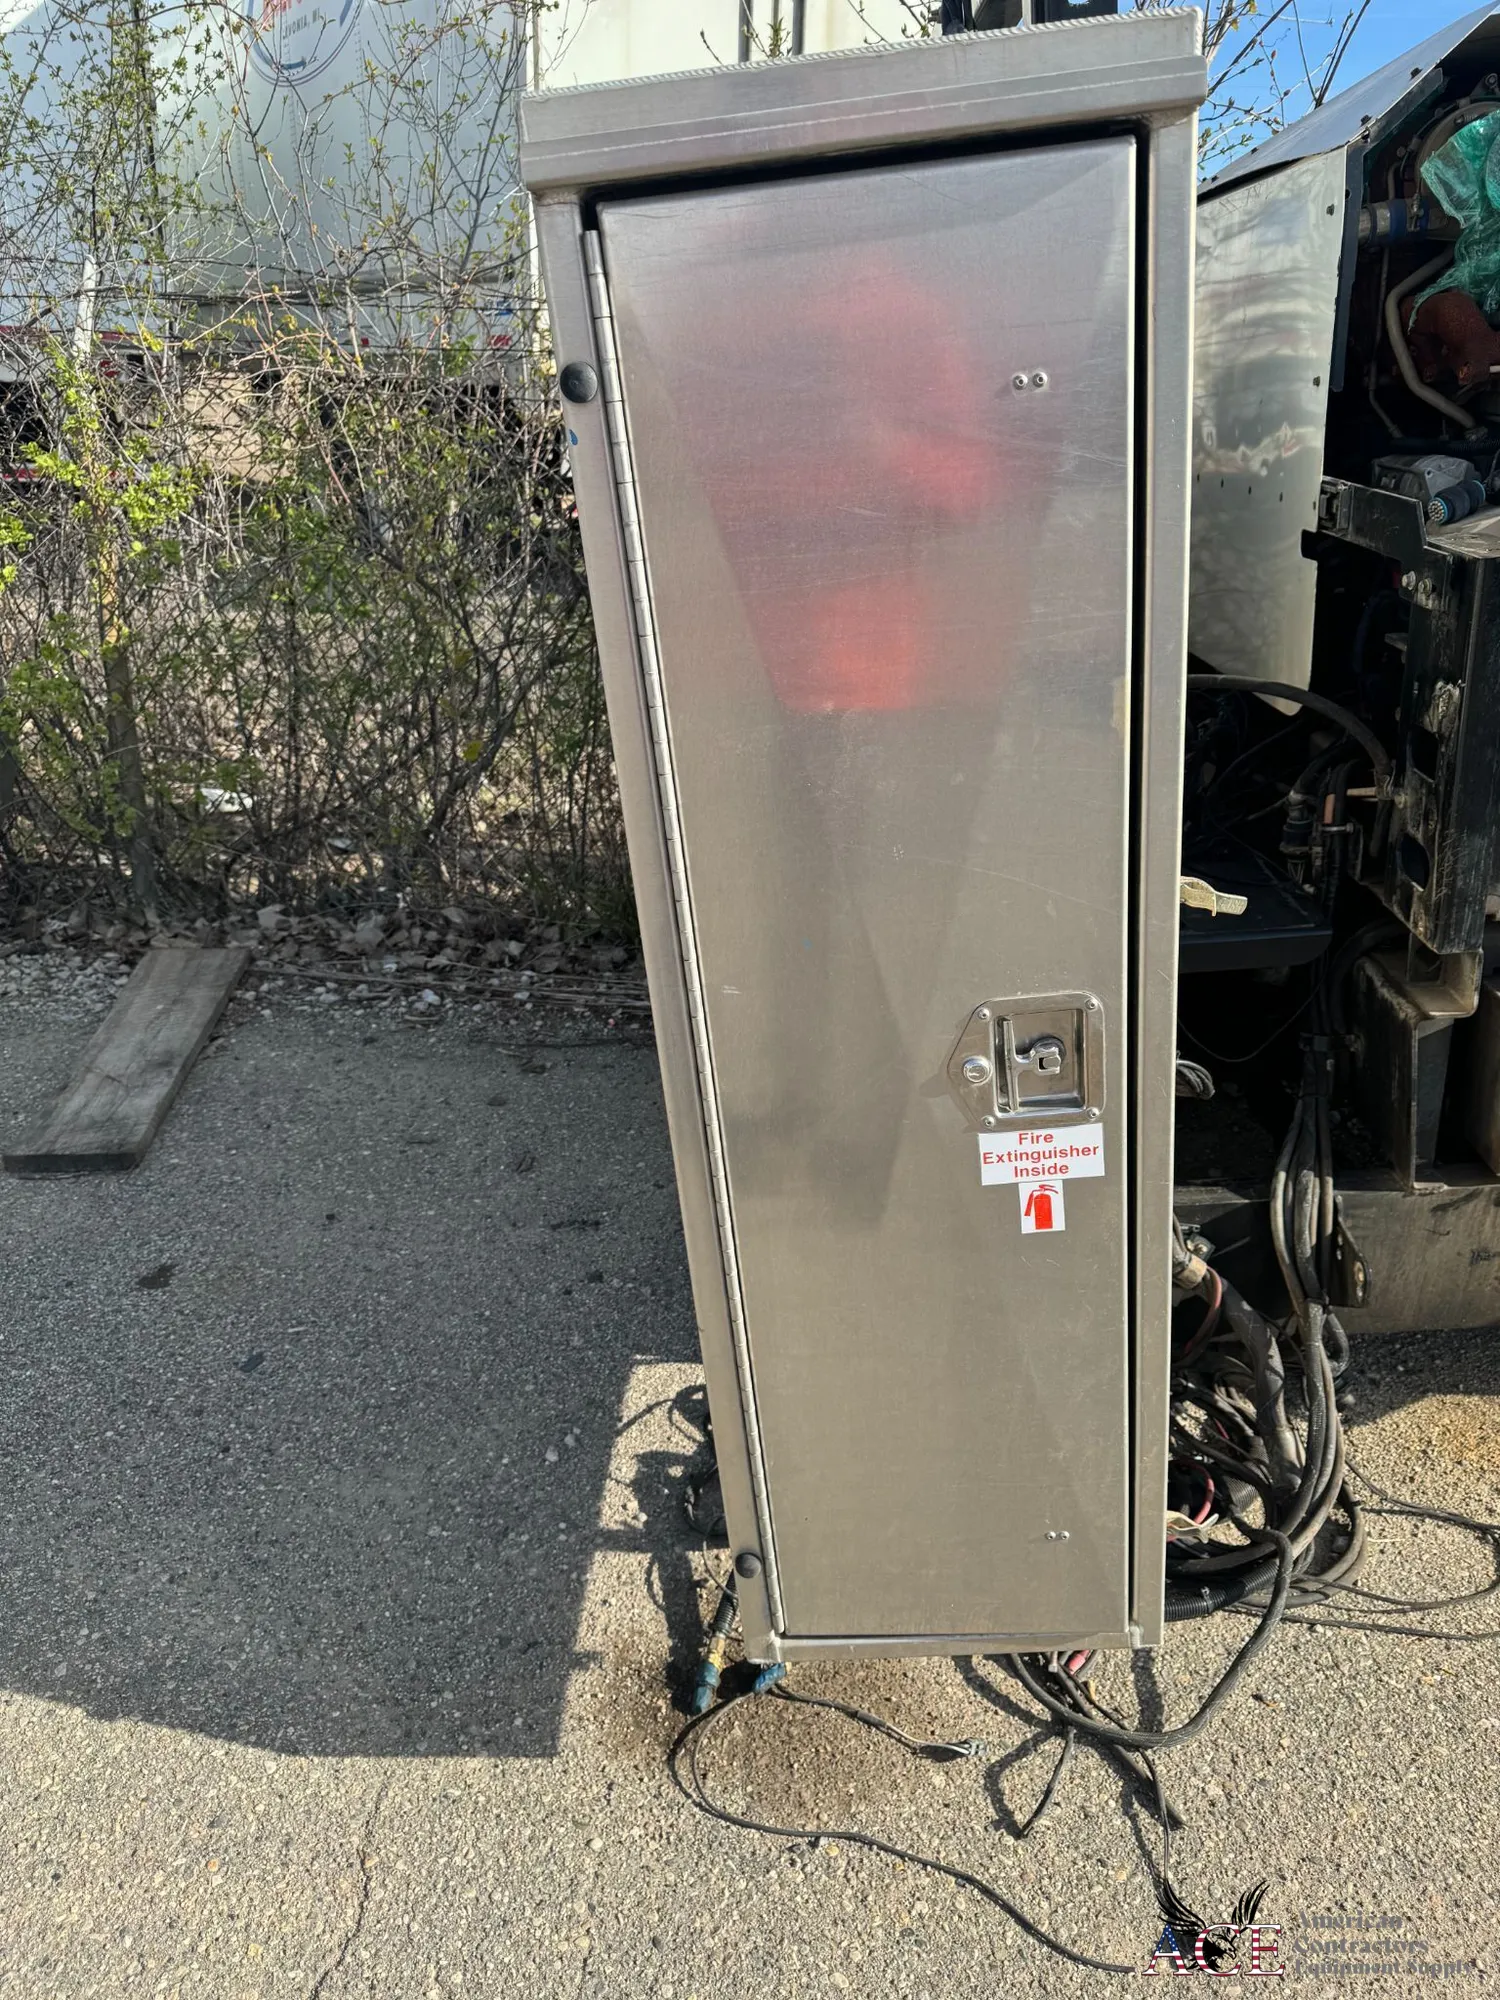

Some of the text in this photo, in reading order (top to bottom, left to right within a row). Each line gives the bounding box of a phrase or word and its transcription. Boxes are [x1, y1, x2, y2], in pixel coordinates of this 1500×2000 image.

[1018, 1132, 1054, 1146] Fire
[982, 1145, 1099, 1165] Extinguisher
[1014, 1163, 1069, 1178] Inside
